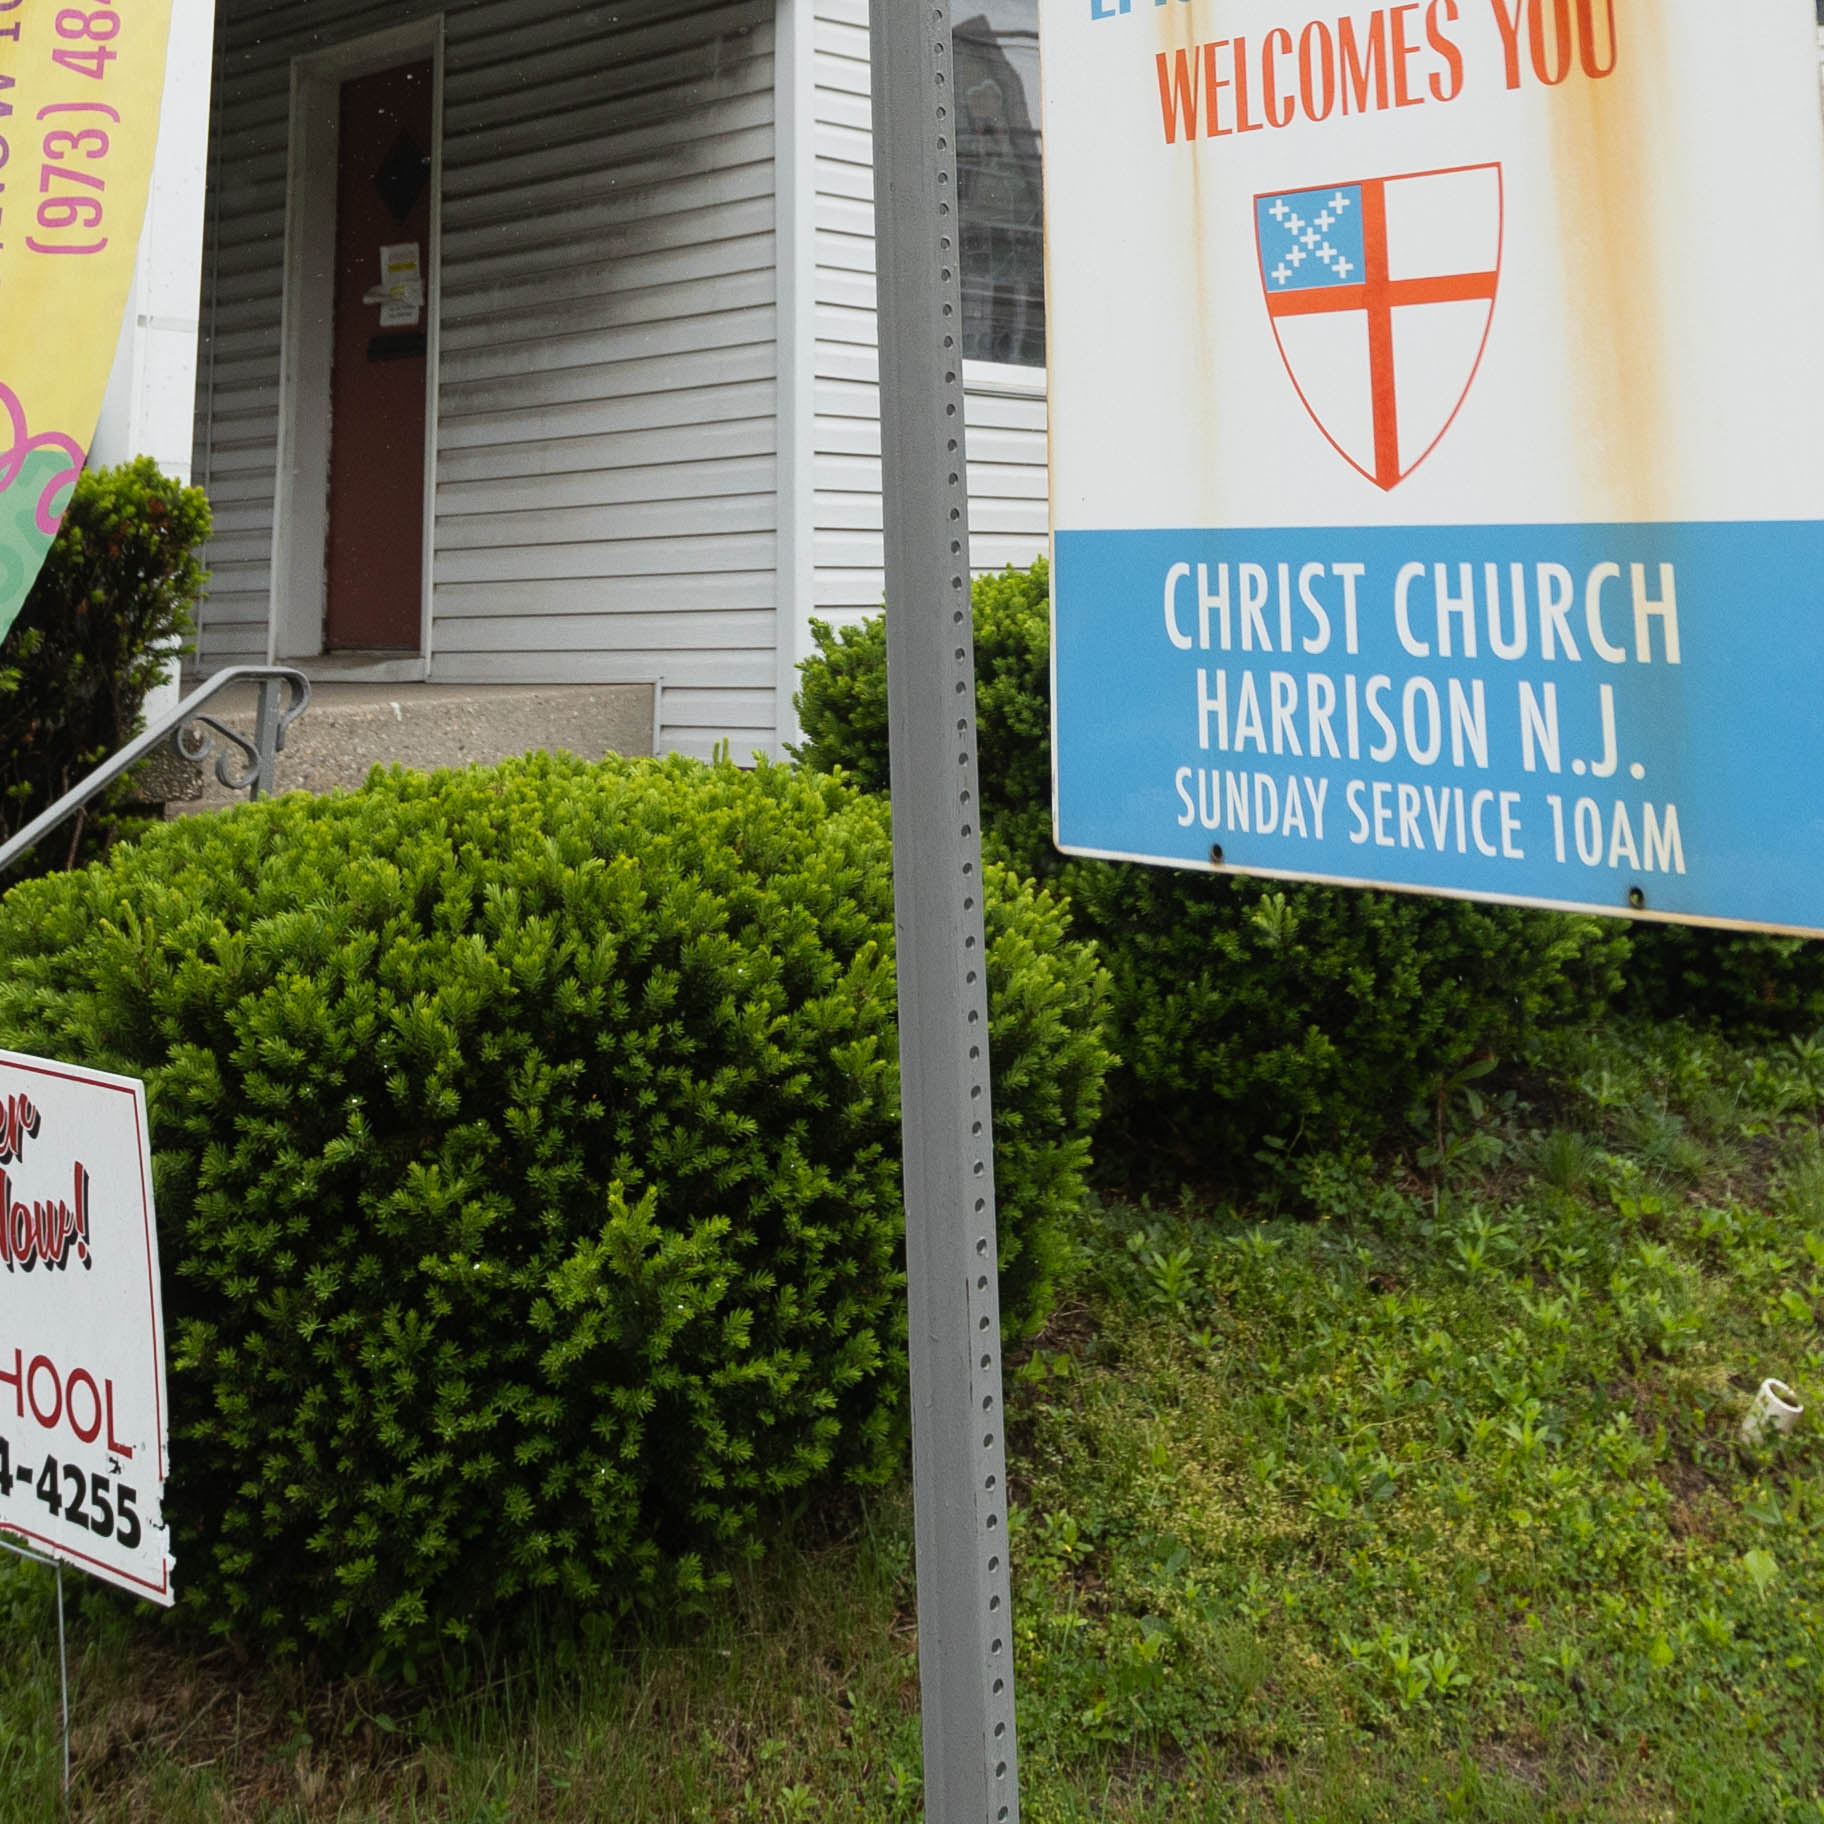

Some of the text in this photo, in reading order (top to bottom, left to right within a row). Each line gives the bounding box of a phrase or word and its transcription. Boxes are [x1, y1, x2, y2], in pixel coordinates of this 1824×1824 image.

[25, 102, 121, 255] (973)
[1163, 561, 1682, 665] CHRIST CHURCH
[1197, 668, 1645, 780] HARRISON N.J.
[1175, 766, 1686, 875] SUNDAY SERVICE 10AM
